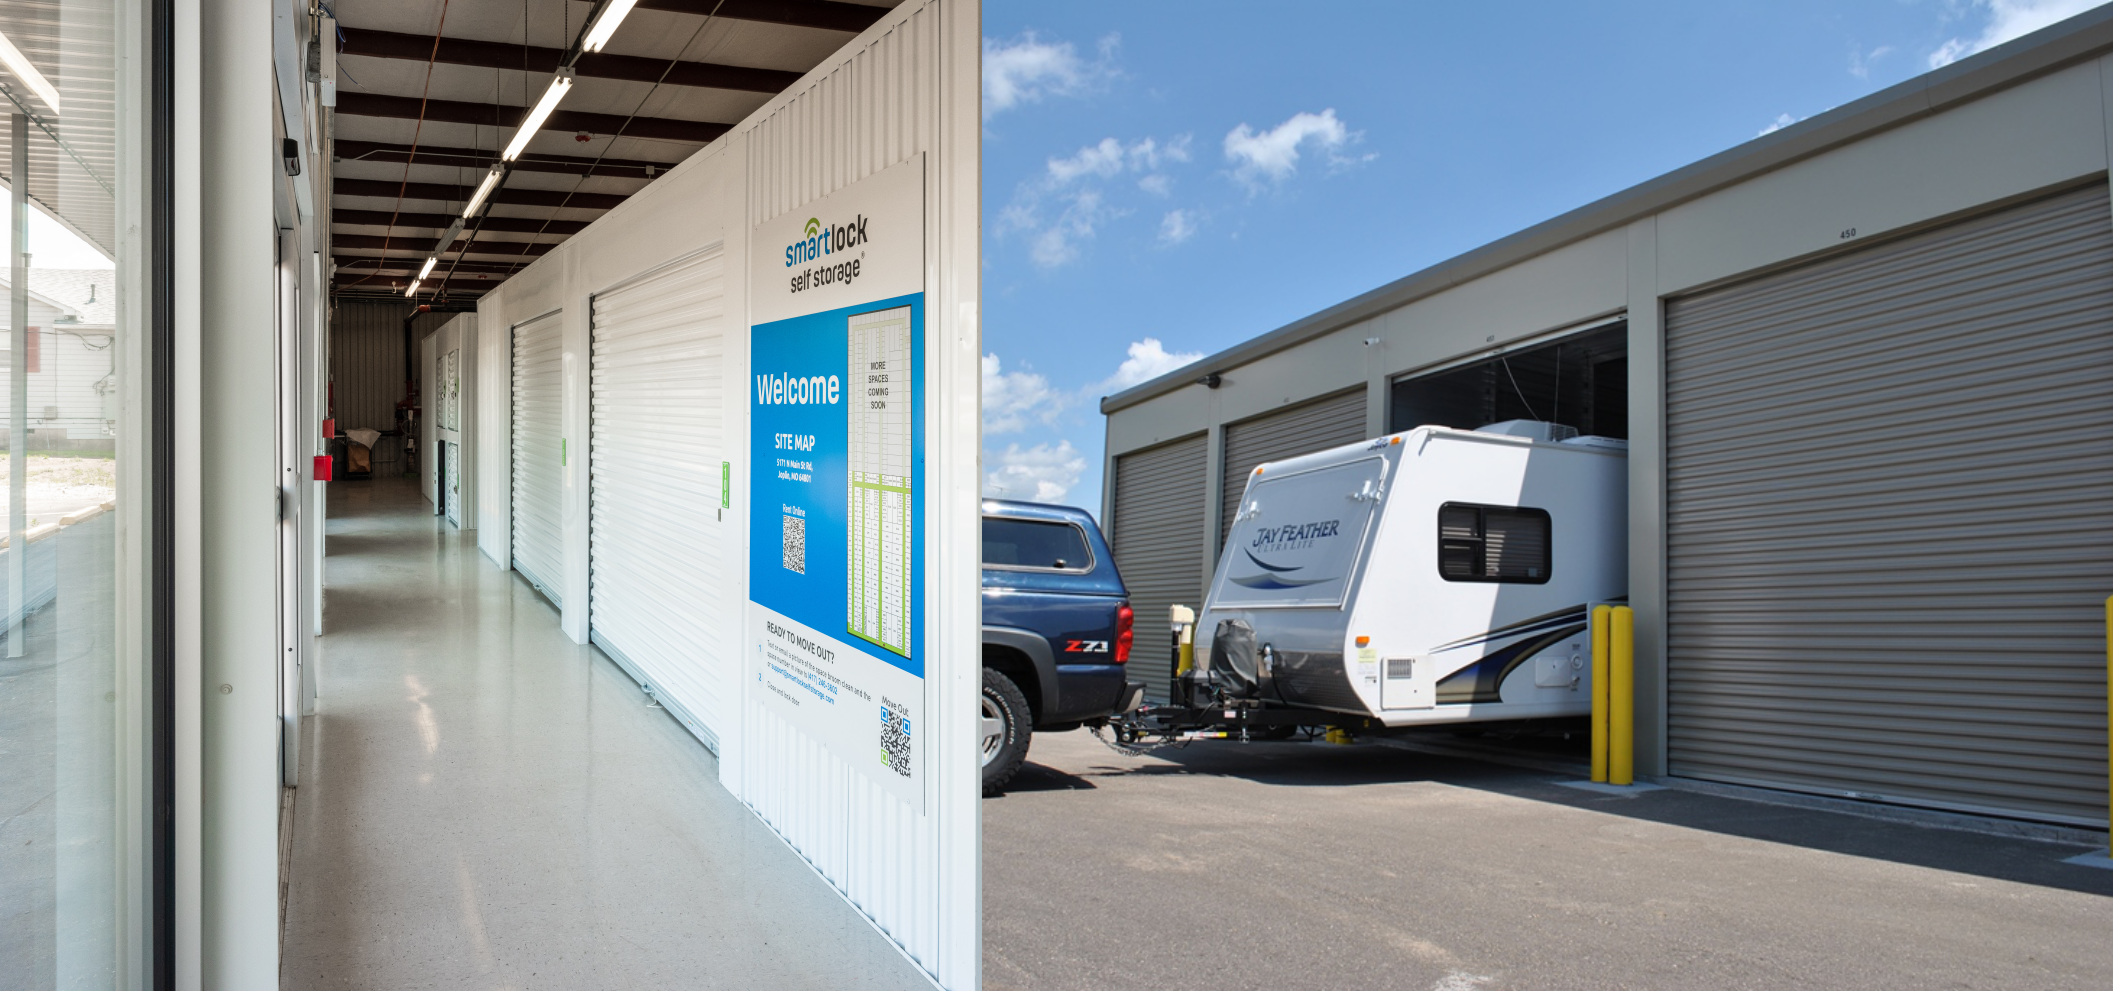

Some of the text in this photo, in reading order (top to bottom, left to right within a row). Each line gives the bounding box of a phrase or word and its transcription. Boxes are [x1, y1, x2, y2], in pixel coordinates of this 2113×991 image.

[1840, 227, 1856, 239] 450
[786, 214, 868, 267] smartlock
[791, 259, 860, 293] self storage
[870, 361, 886, 370] MORE
[868, 374, 889, 383] SPACES
[757, 372, 840, 404] Welcome
[868, 388, 889, 396] COMING
[870, 401, 886, 409] SOON
[775, 433, 815, 451] SITE MAP
[777, 458, 785, 467] 5171
[791, 460, 800, 469] Main
[801, 461, 805, 470] St
[791, 472, 798, 481] MO
[783, 504, 805, 517] Rent Online
[1253, 519, 1340, 547] JAY FEATHER
[1257, 540, 1315, 553] ULTRA LITE
[767, 621, 834, 664] READY TO MOVE OUT?
[1064, 640, 1108, 652] Z71
[767, 680, 776, 692] Close
[863, 691, 871, 702] the
[882, 695, 909, 717] Move Out
